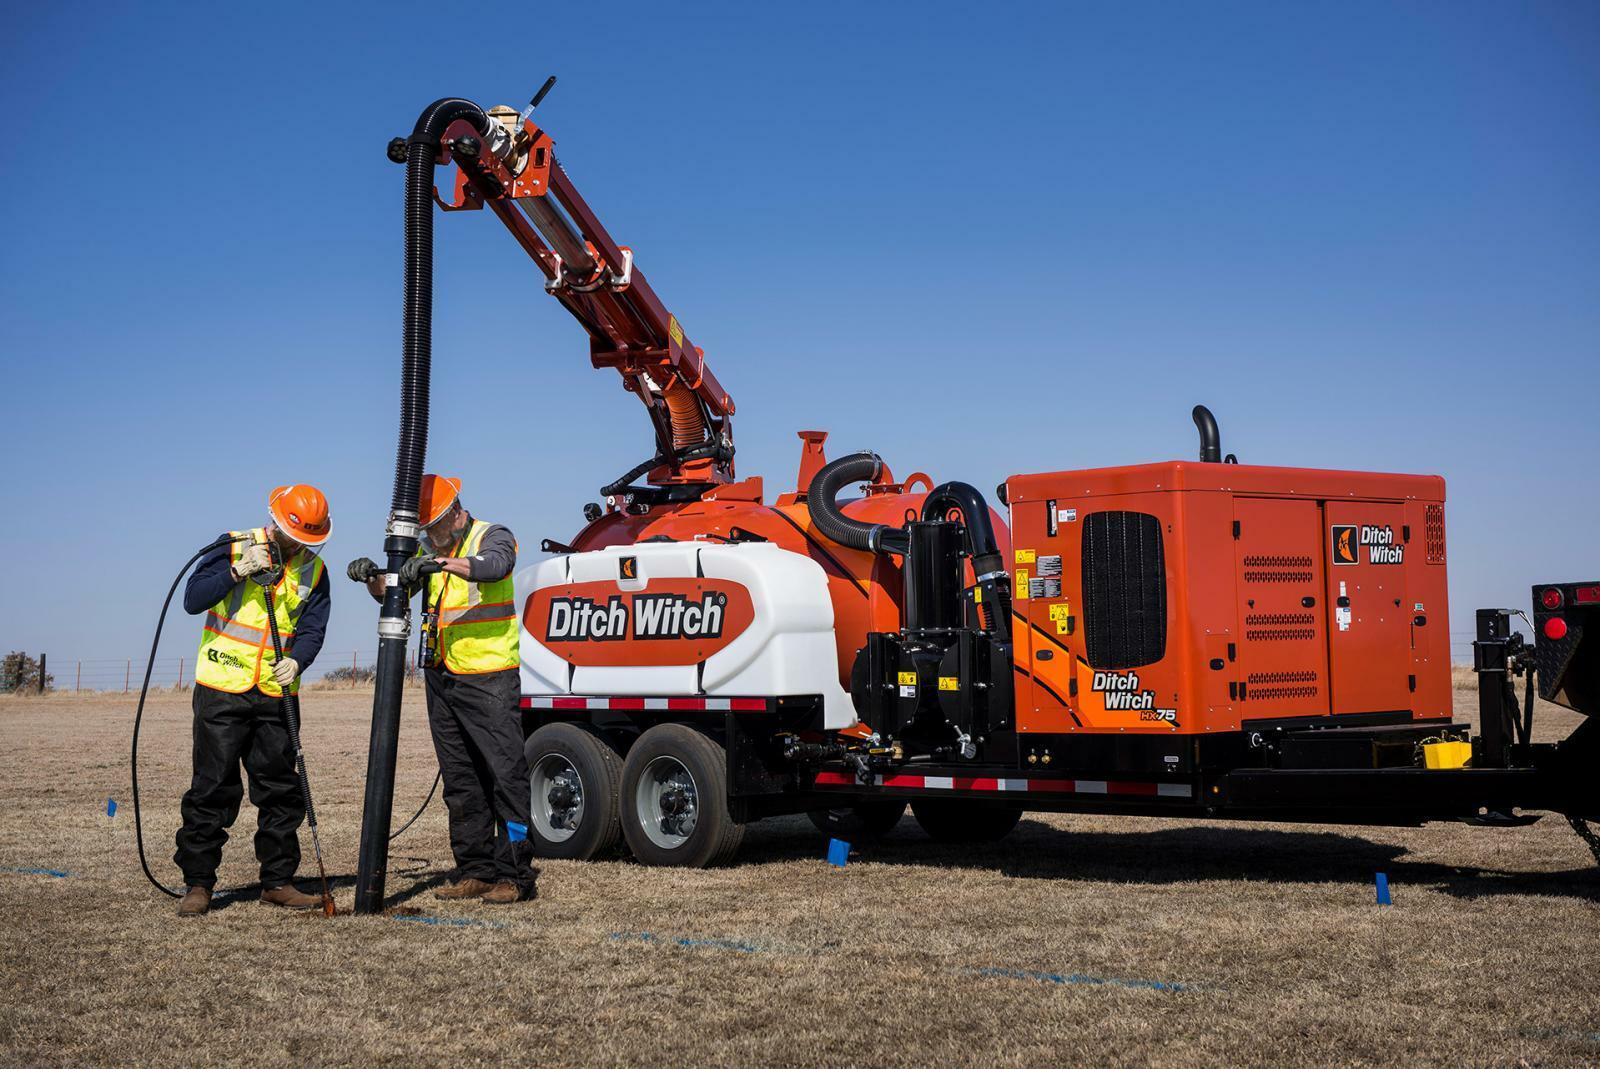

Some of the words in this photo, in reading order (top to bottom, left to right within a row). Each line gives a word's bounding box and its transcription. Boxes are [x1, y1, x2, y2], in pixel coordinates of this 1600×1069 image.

[1360, 526, 1393, 544] Ditch
[1370, 545, 1403, 563] Witch
[547, 599, 627, 638] Ditch
[634, 596, 723, 637] Witch
[1092, 672, 1138, 691] Ditch
[1104, 691, 1153, 709] Witch
